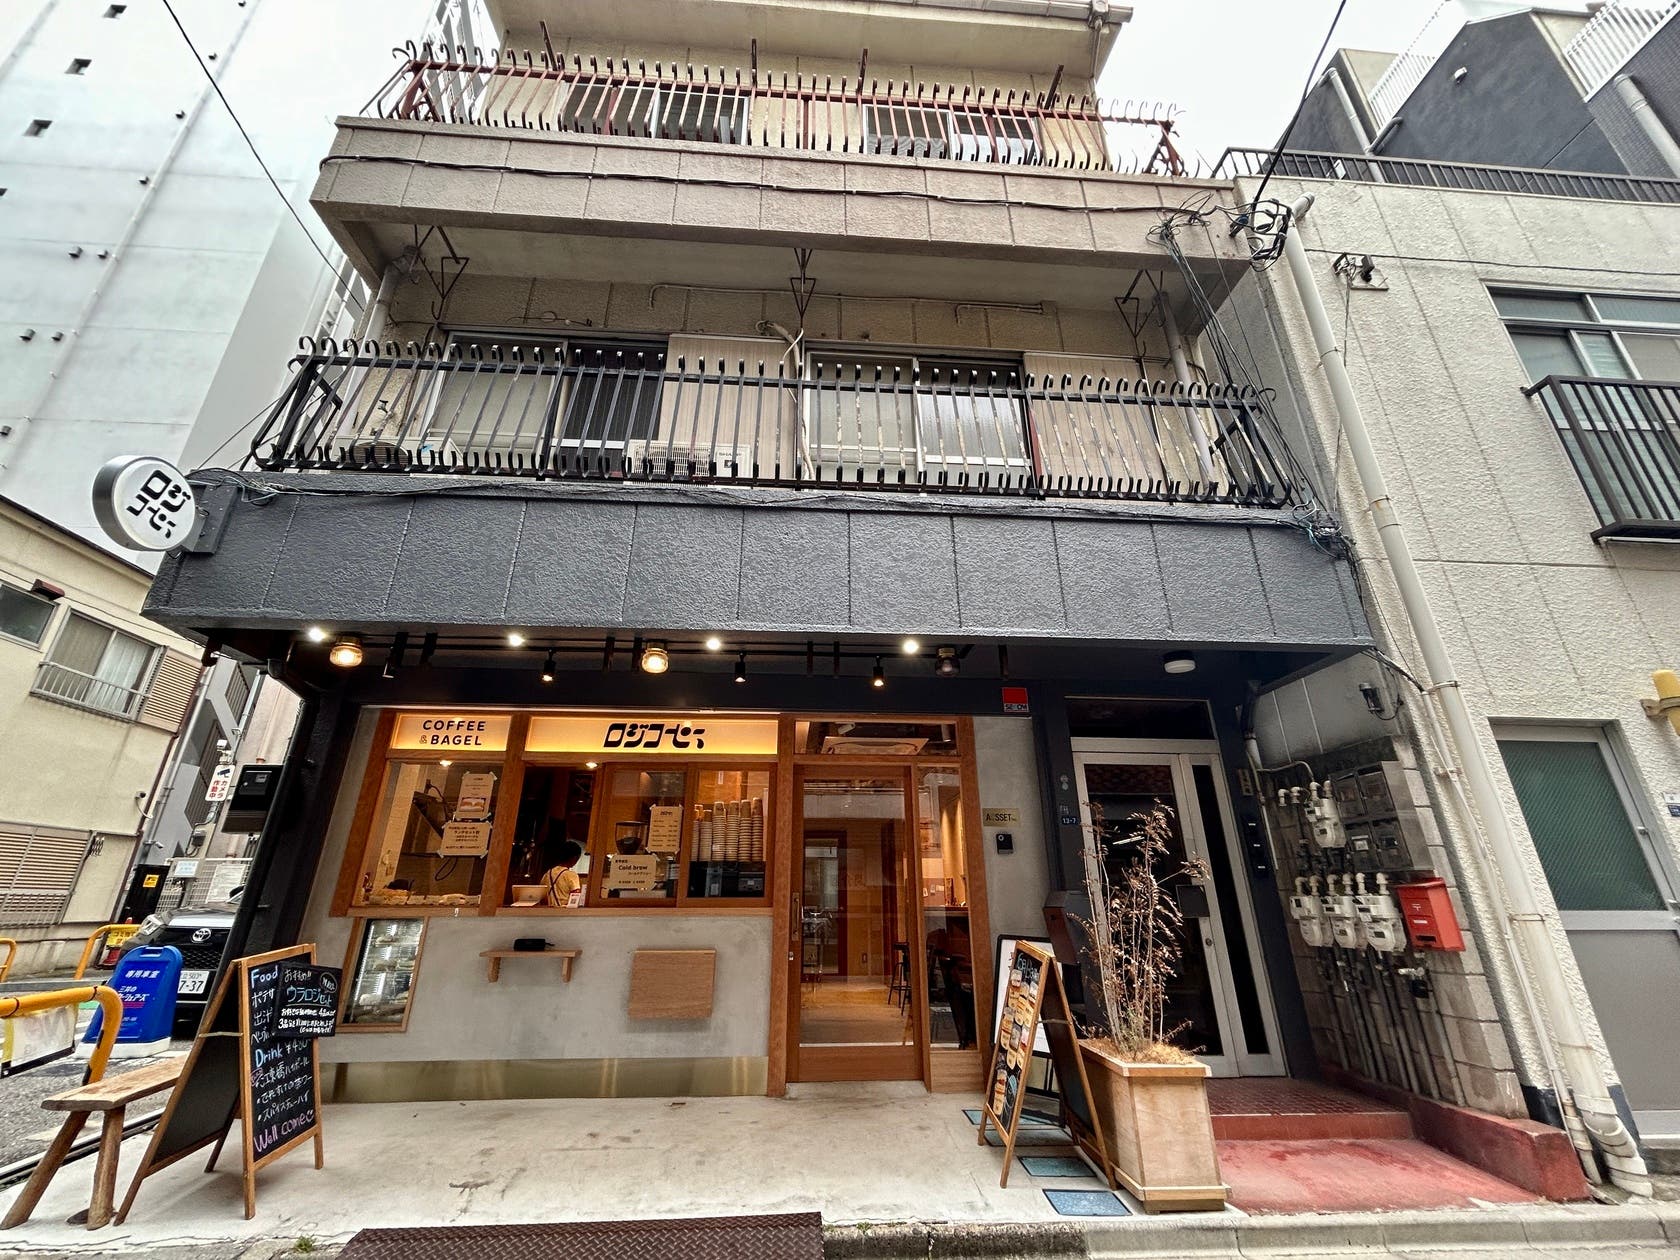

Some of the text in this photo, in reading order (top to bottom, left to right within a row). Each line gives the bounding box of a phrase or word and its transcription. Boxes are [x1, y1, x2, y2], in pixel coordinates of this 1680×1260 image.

[422, 719, 486, 731] COFFEE
[430, 734, 482, 746] BAGEL
[250, 964, 279, 989] Food
[255, 1043, 284, 1068] Drink
[253, 1112, 307, 1152] Well come
